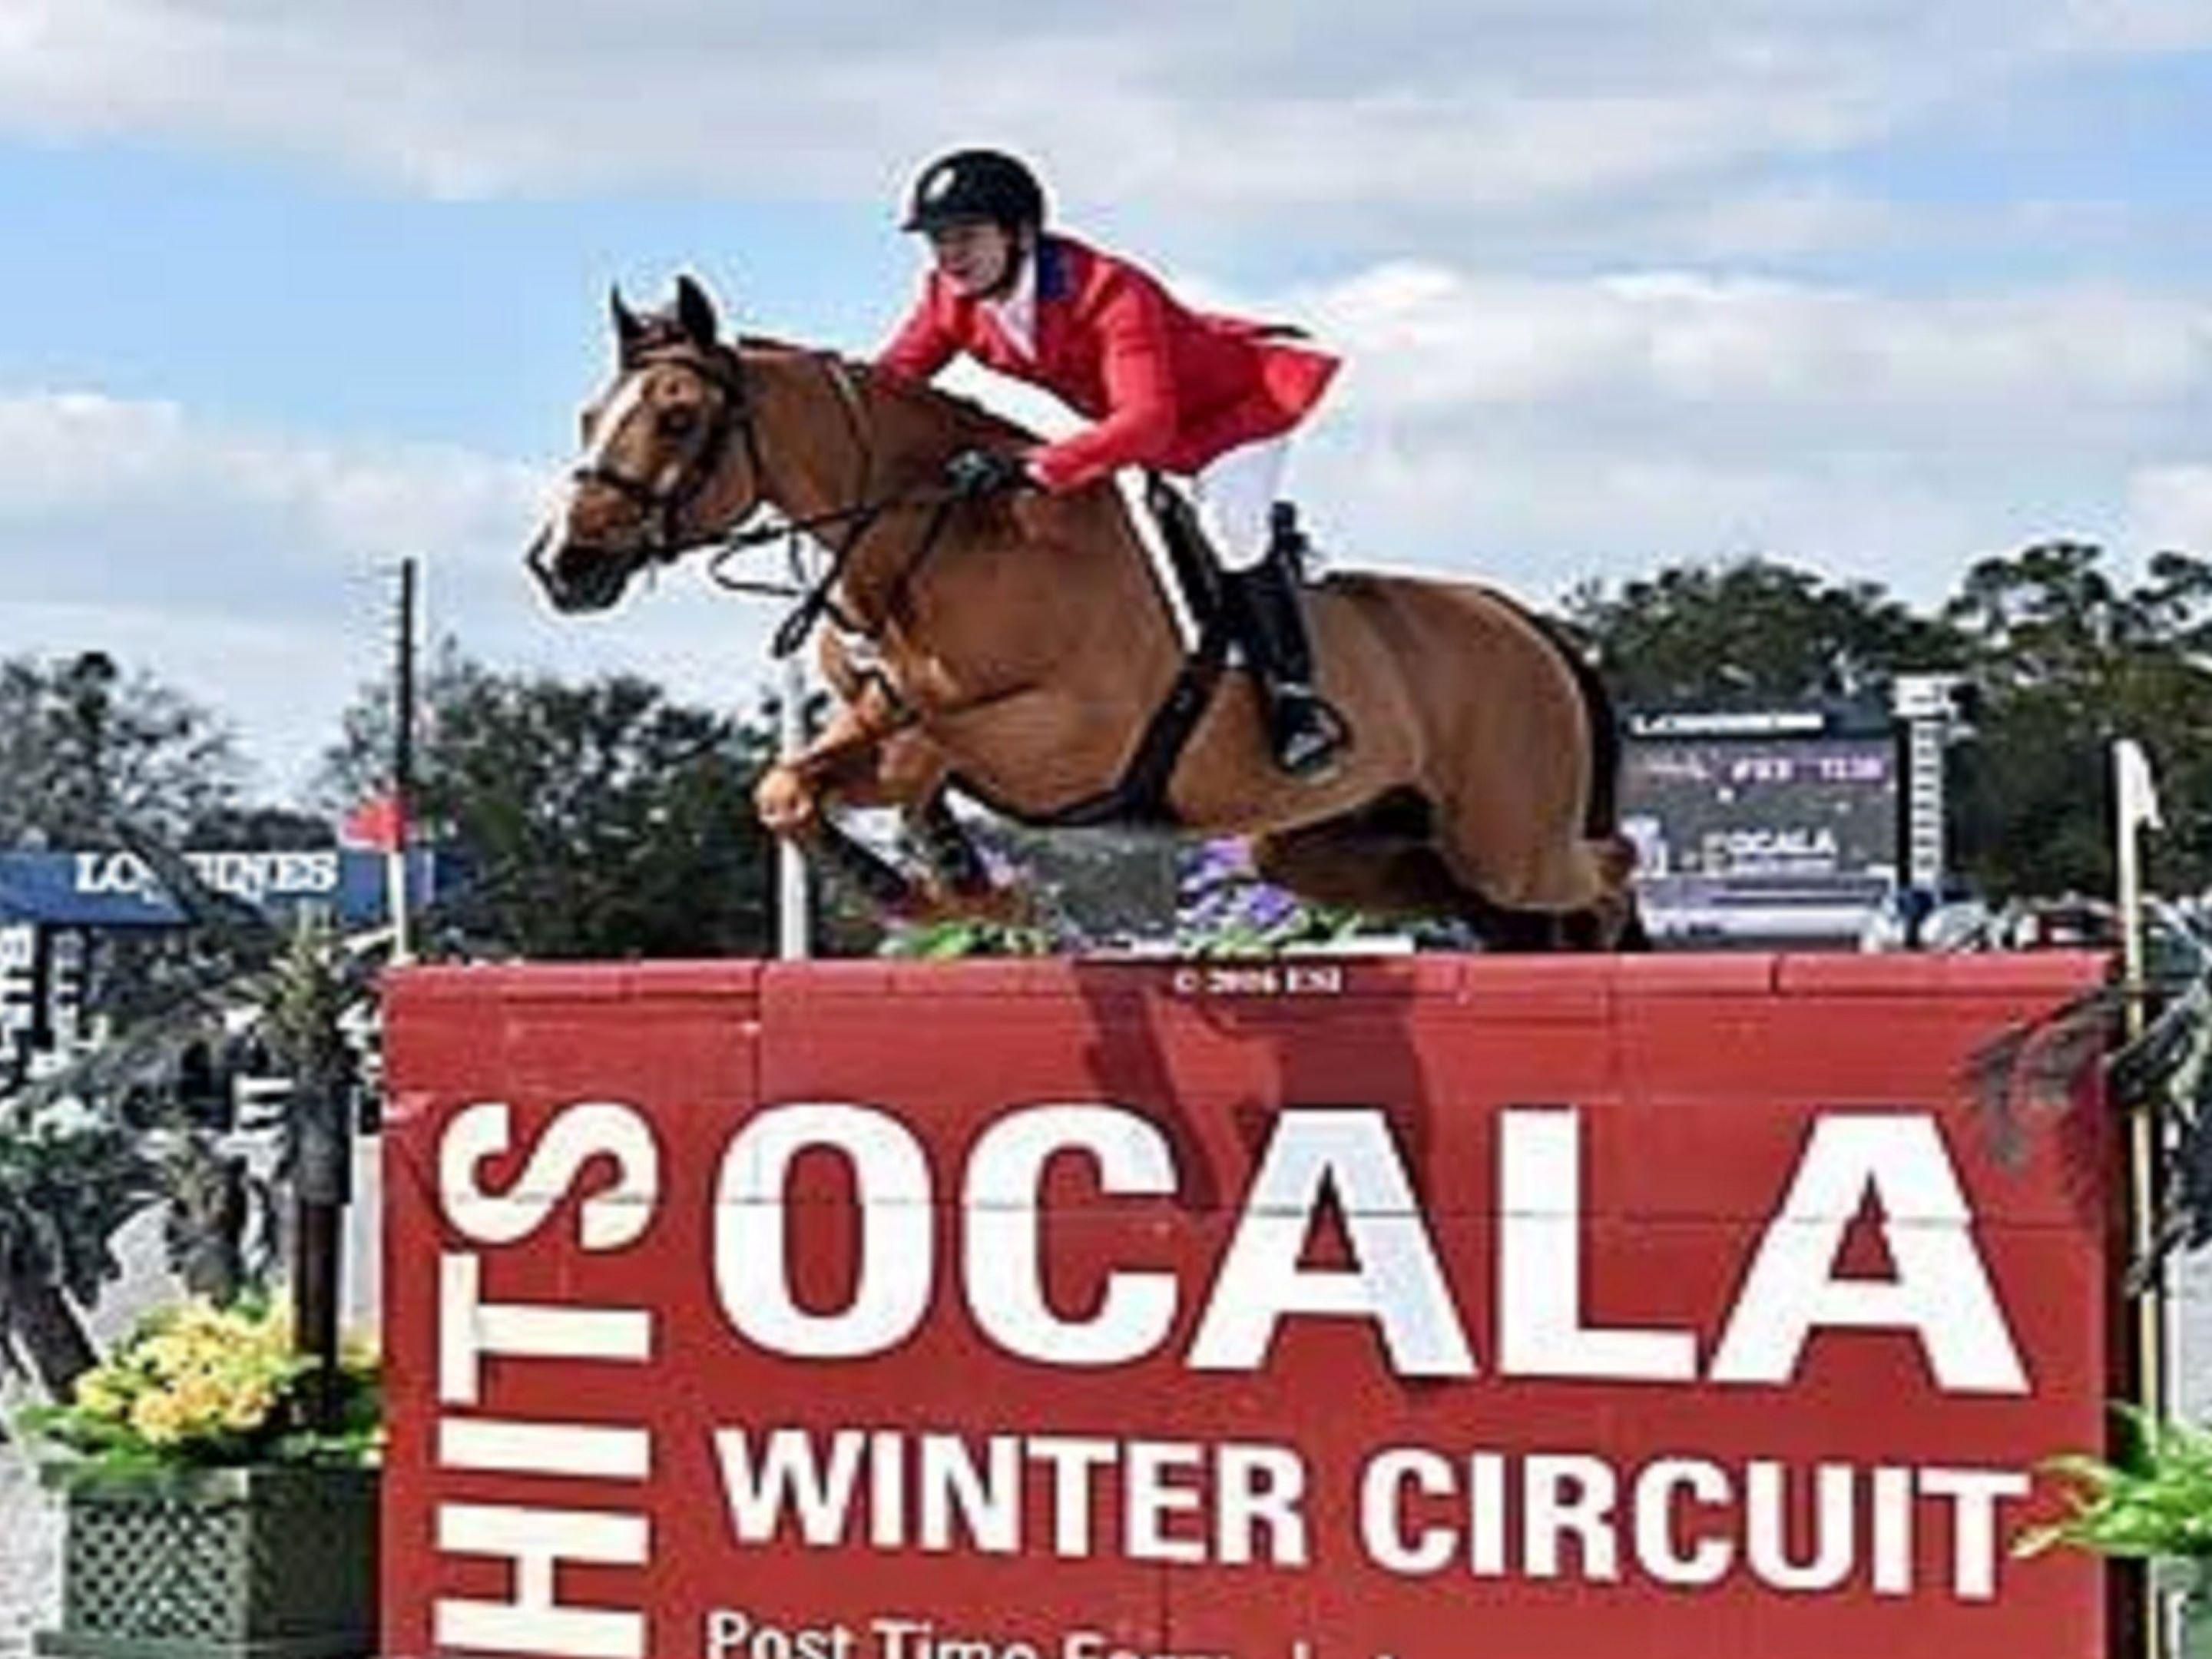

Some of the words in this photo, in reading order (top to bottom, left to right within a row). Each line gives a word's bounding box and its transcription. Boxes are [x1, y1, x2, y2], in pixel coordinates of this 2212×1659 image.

[75, 849, 339, 893] LOINES
[713, 1101, 2031, 1396] OCALA
[432, 1096, 660, 1659] HITS
[713, 1426, 1309, 1568] WINTER
[1360, 1449, 2032, 1600] CIRCUIT
